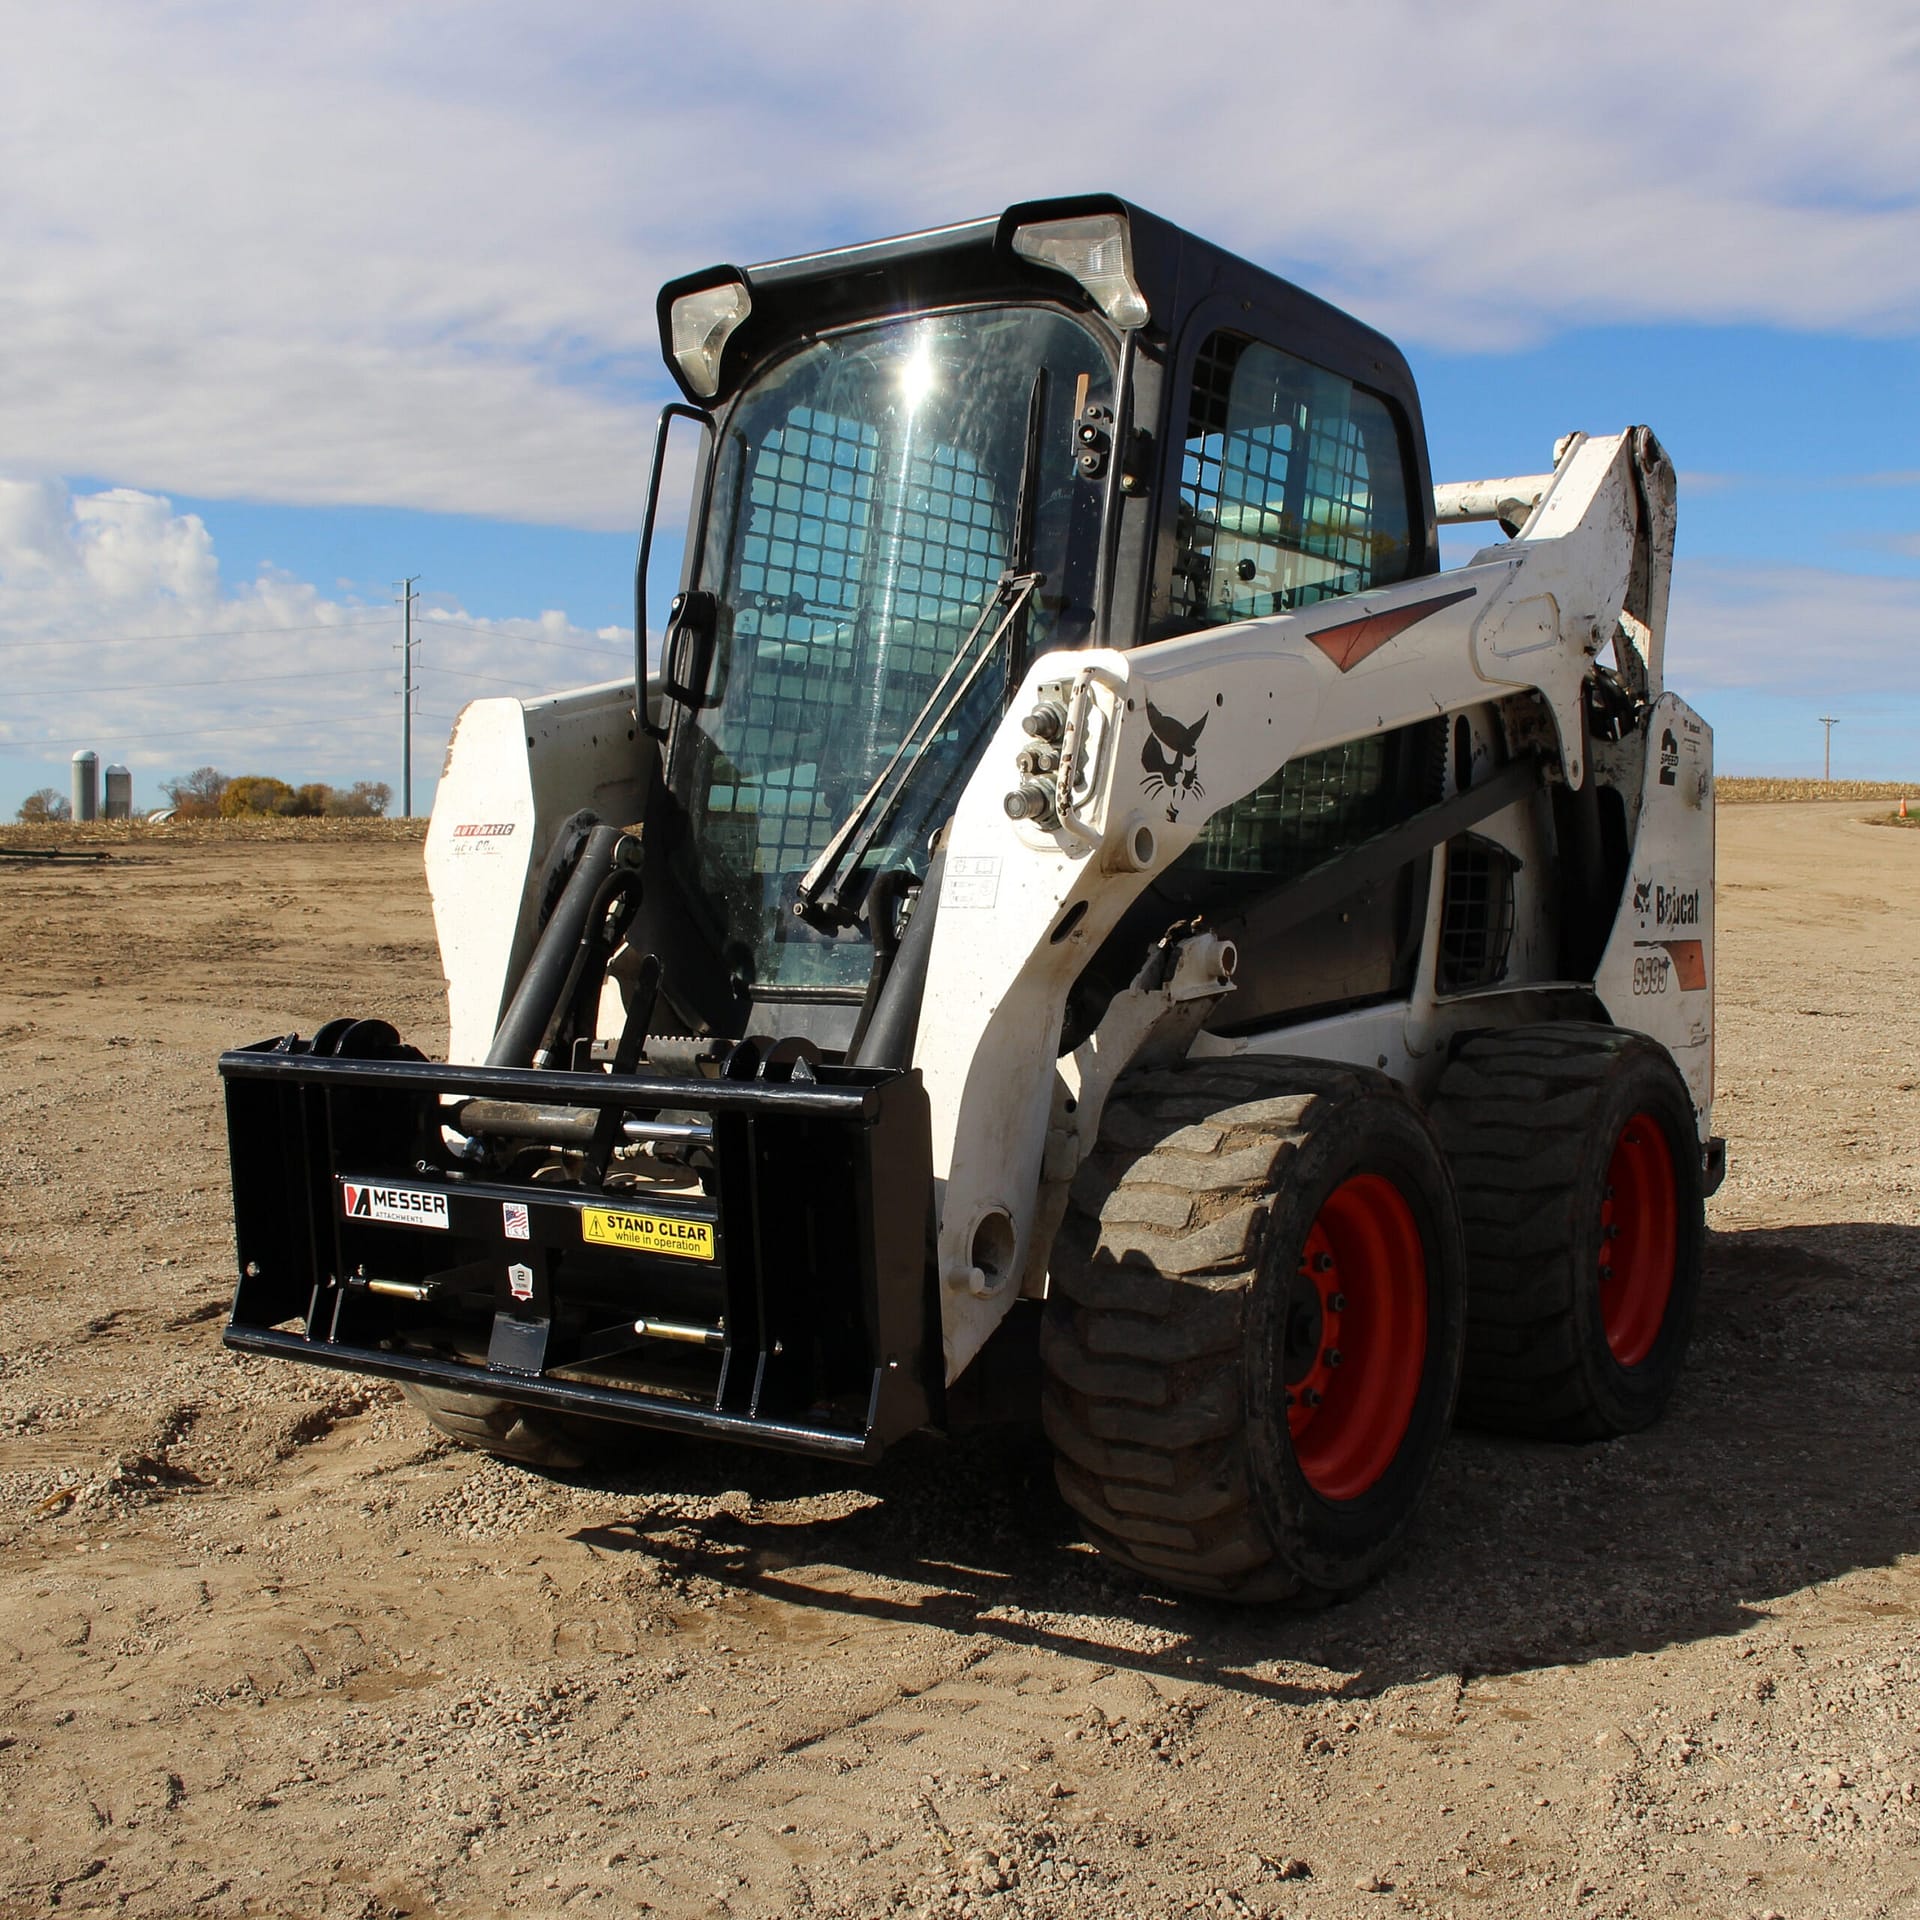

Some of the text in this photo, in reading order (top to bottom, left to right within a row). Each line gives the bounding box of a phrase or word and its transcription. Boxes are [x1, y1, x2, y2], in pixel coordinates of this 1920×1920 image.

[1660, 753, 1679, 767] SPEED
[454, 824, 514, 836] AUTOMATIC
[373, 1188, 446, 1214] MESSER
[375, 1211, 423, 1224] ATTACHMENTS
[607, 1215, 707, 1241] STAND CLEAR
[615, 1231, 700, 1252] while in operation
[517, 1270, 525, 1281] 2
